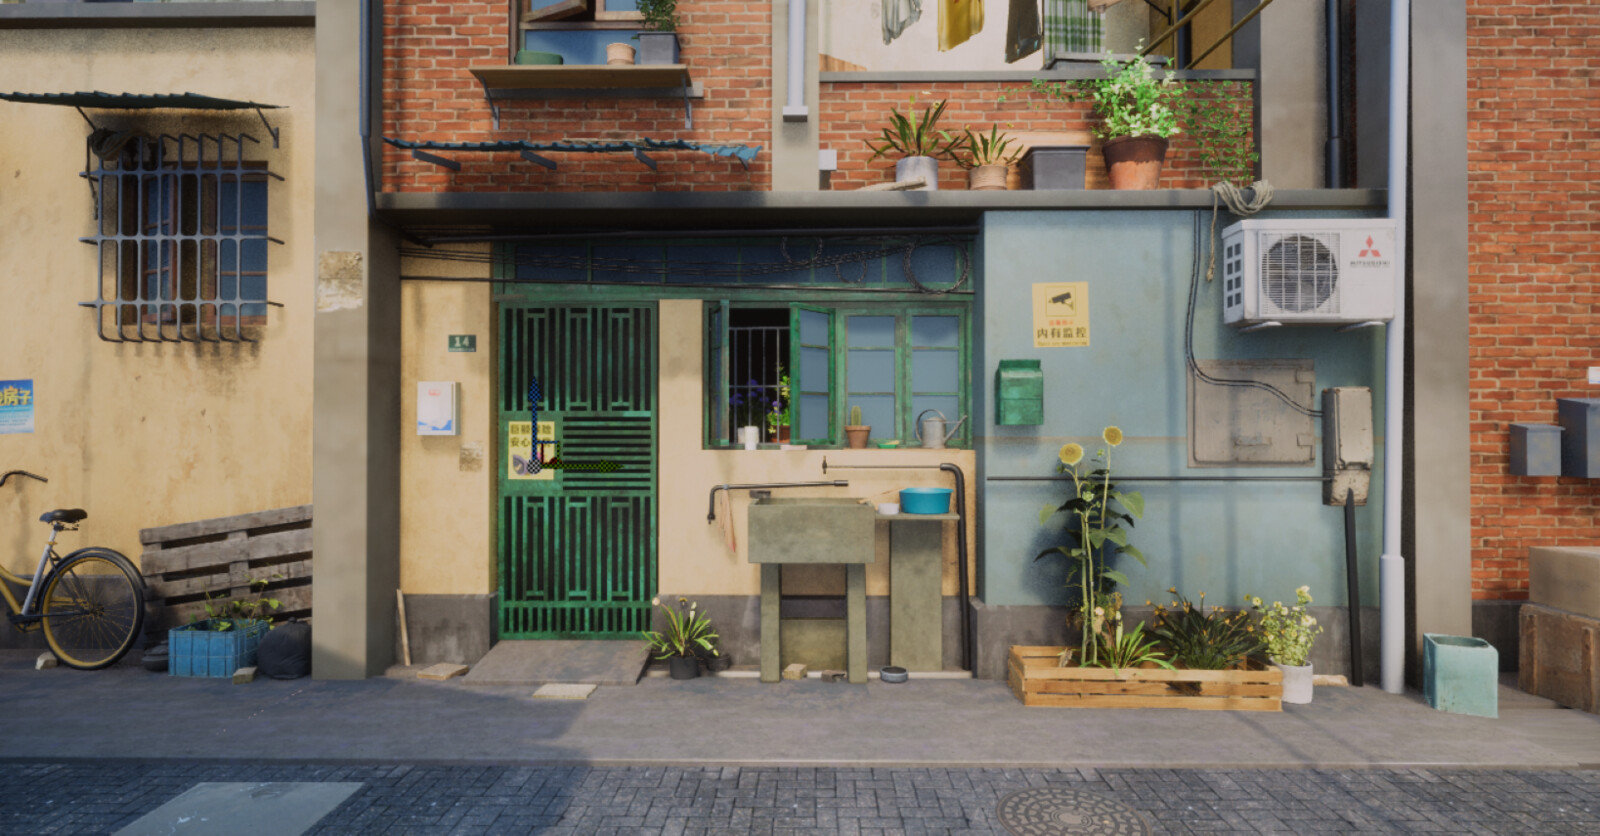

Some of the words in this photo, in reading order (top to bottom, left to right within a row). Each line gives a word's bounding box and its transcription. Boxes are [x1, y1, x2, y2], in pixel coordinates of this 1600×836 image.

[1037, 327, 1087, 339] 内有监控
[454, 336, 470, 347] 14
